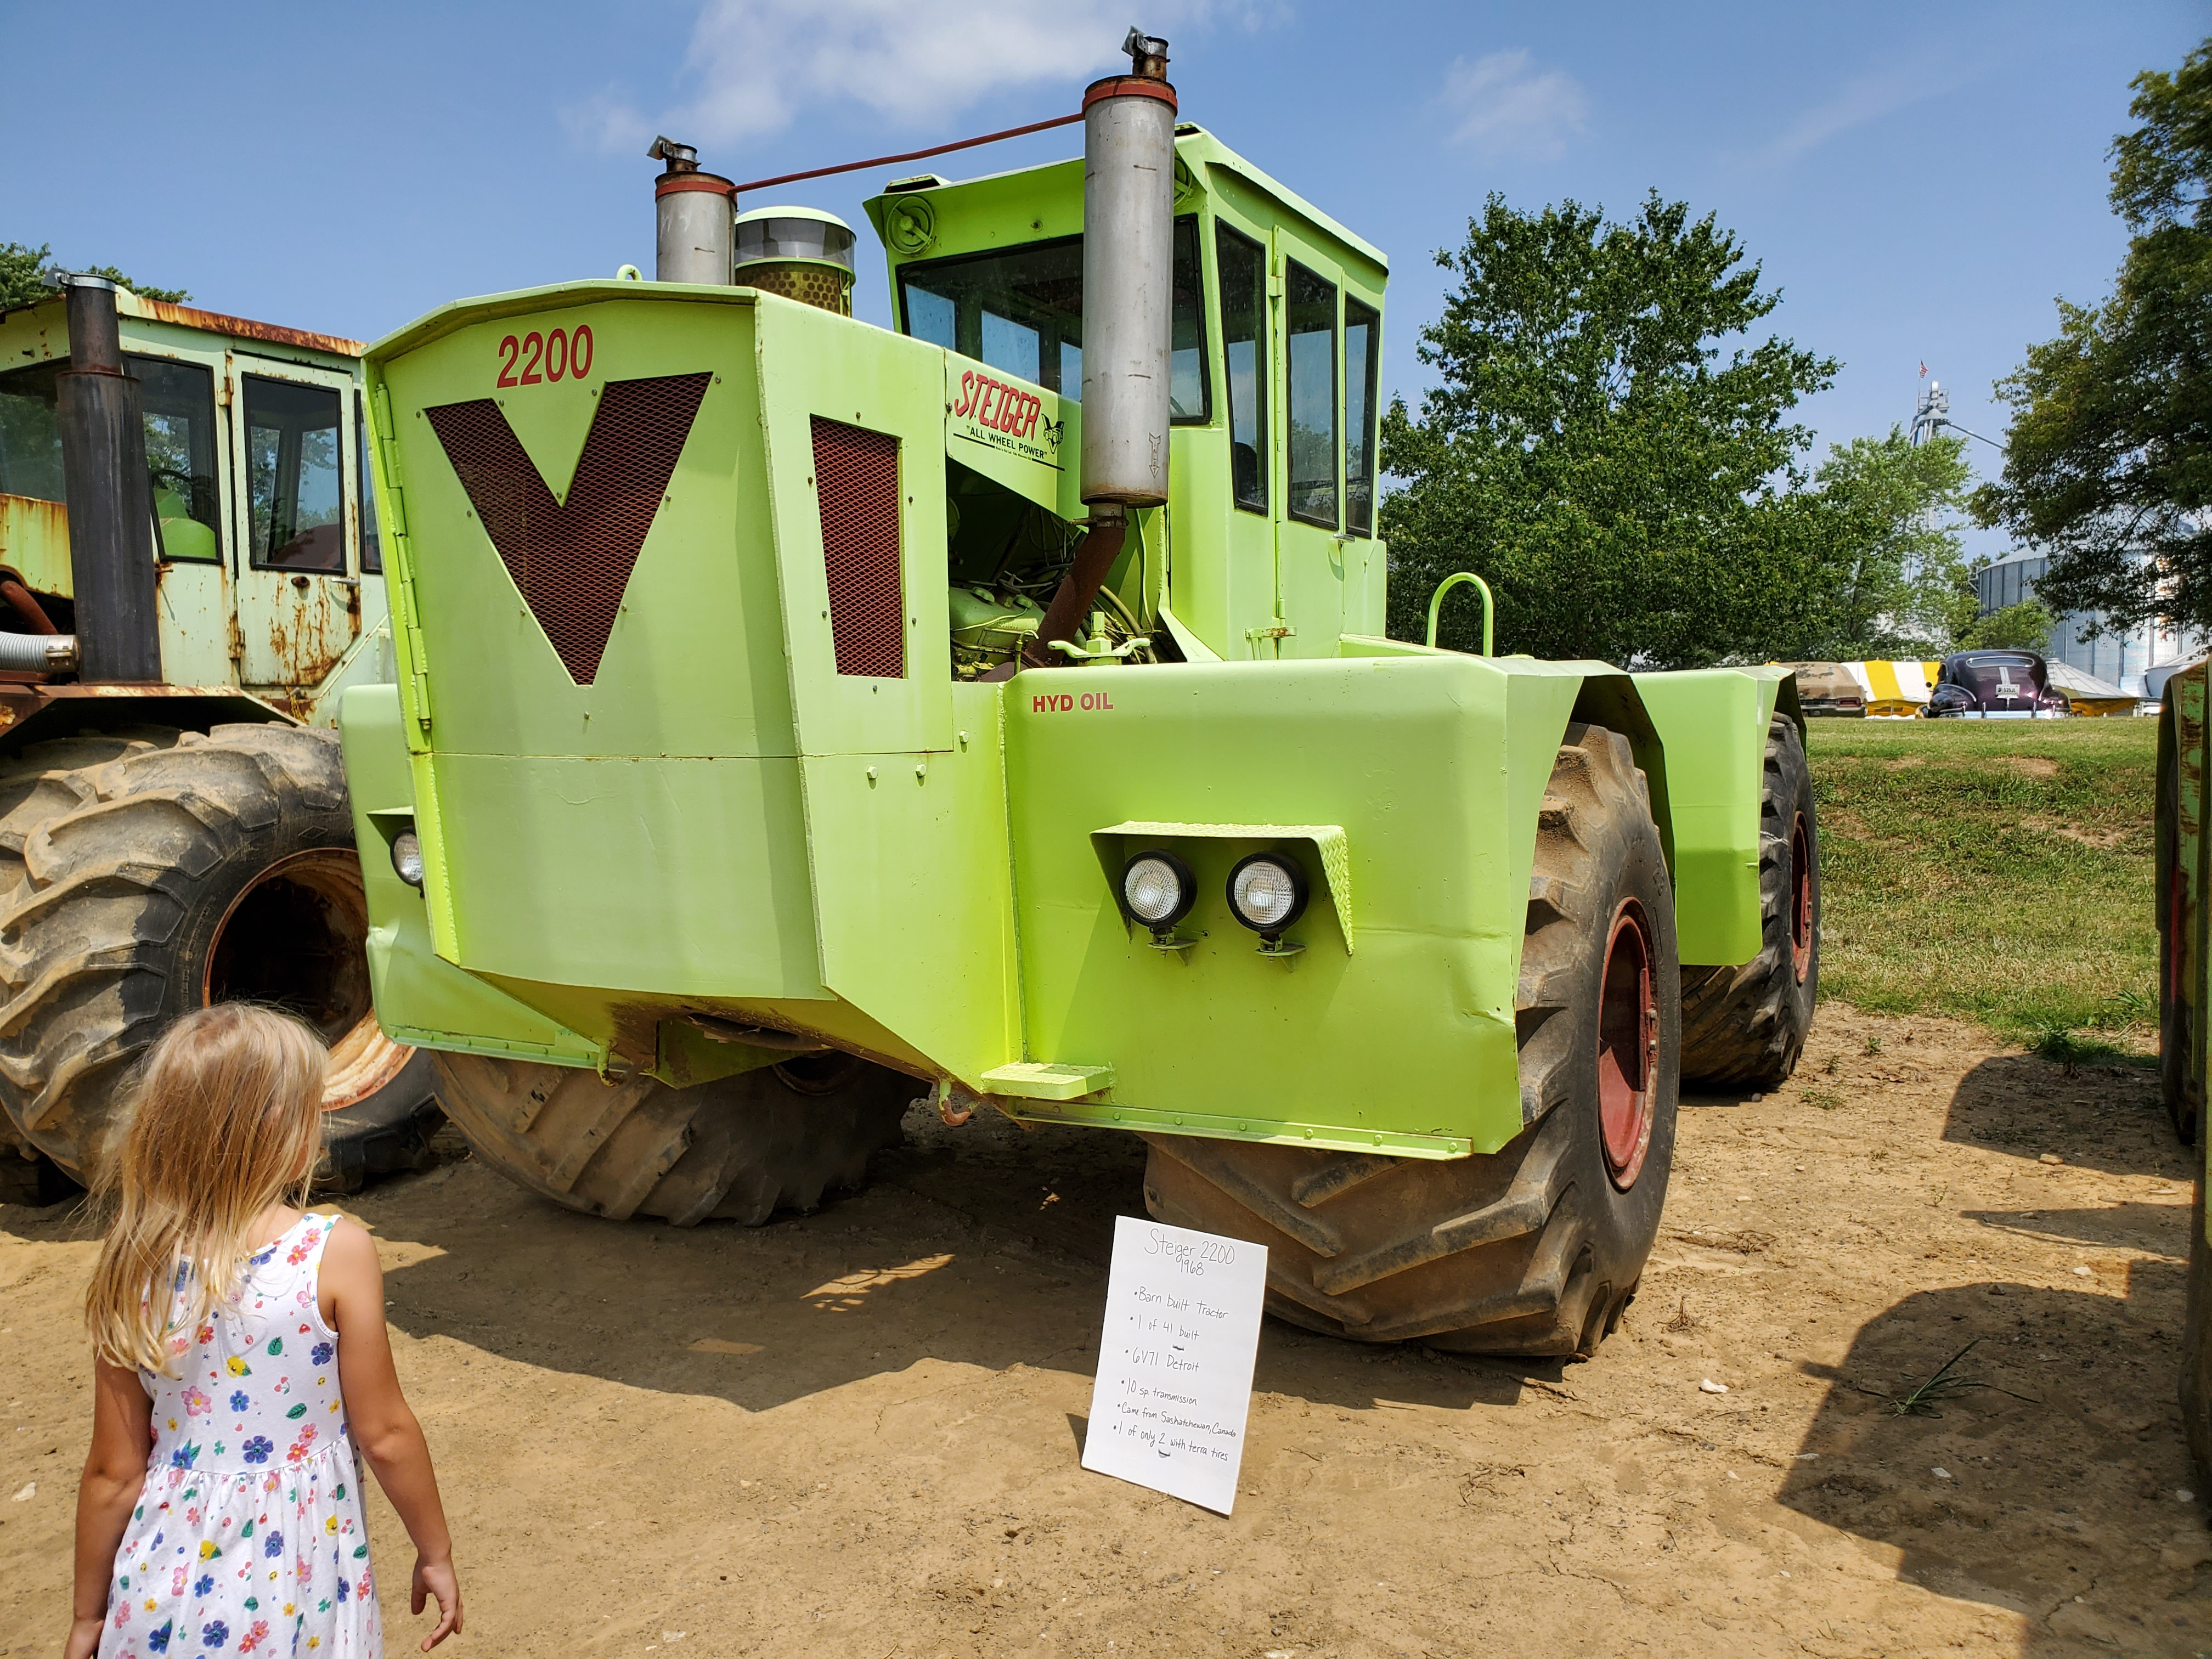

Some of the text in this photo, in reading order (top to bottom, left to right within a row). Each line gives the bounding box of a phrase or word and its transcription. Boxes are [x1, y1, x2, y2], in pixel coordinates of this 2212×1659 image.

[496, 324, 593, 389] 2200
[954, 370, 1041, 441] STEIGER
[966, 425, 985, 440] "ALL
[988, 432, 1016, 450] WHEEL
[1018, 443, 1047, 460] POWER"
[1032, 692, 1114, 713] HYD OIL
[1144, 1228, 1235, 1264] Steiger 2200
[1180, 1259, 1204, 1276] 1968
[1138, 1286, 1161, 1304] Barn
[1167, 1294, 1190, 1311] built
[1148, 1318, 1158, 1331] of
[1163, 1321, 1173, 1334] 41
[1179, 1325, 1199, 1340] built
[1132, 1347, 1200, 1372] 6V71 Detroit
[1126, 1378, 1137, 1395] 10
[1153, 1387, 1197, 1406] transmission
[1121, 1402, 1139, 1415] Came
[1142, 1407, 1157, 1419] from
[1128, 1425, 1137, 1436] of
[1141, 1430, 1155, 1447] only
[1158, 1433, 1165, 1444] 2
[1170, 1437, 1186, 1450] with
[1188, 1441, 1207, 1454] terra
[1211, 1447, 1228, 1462] tires
